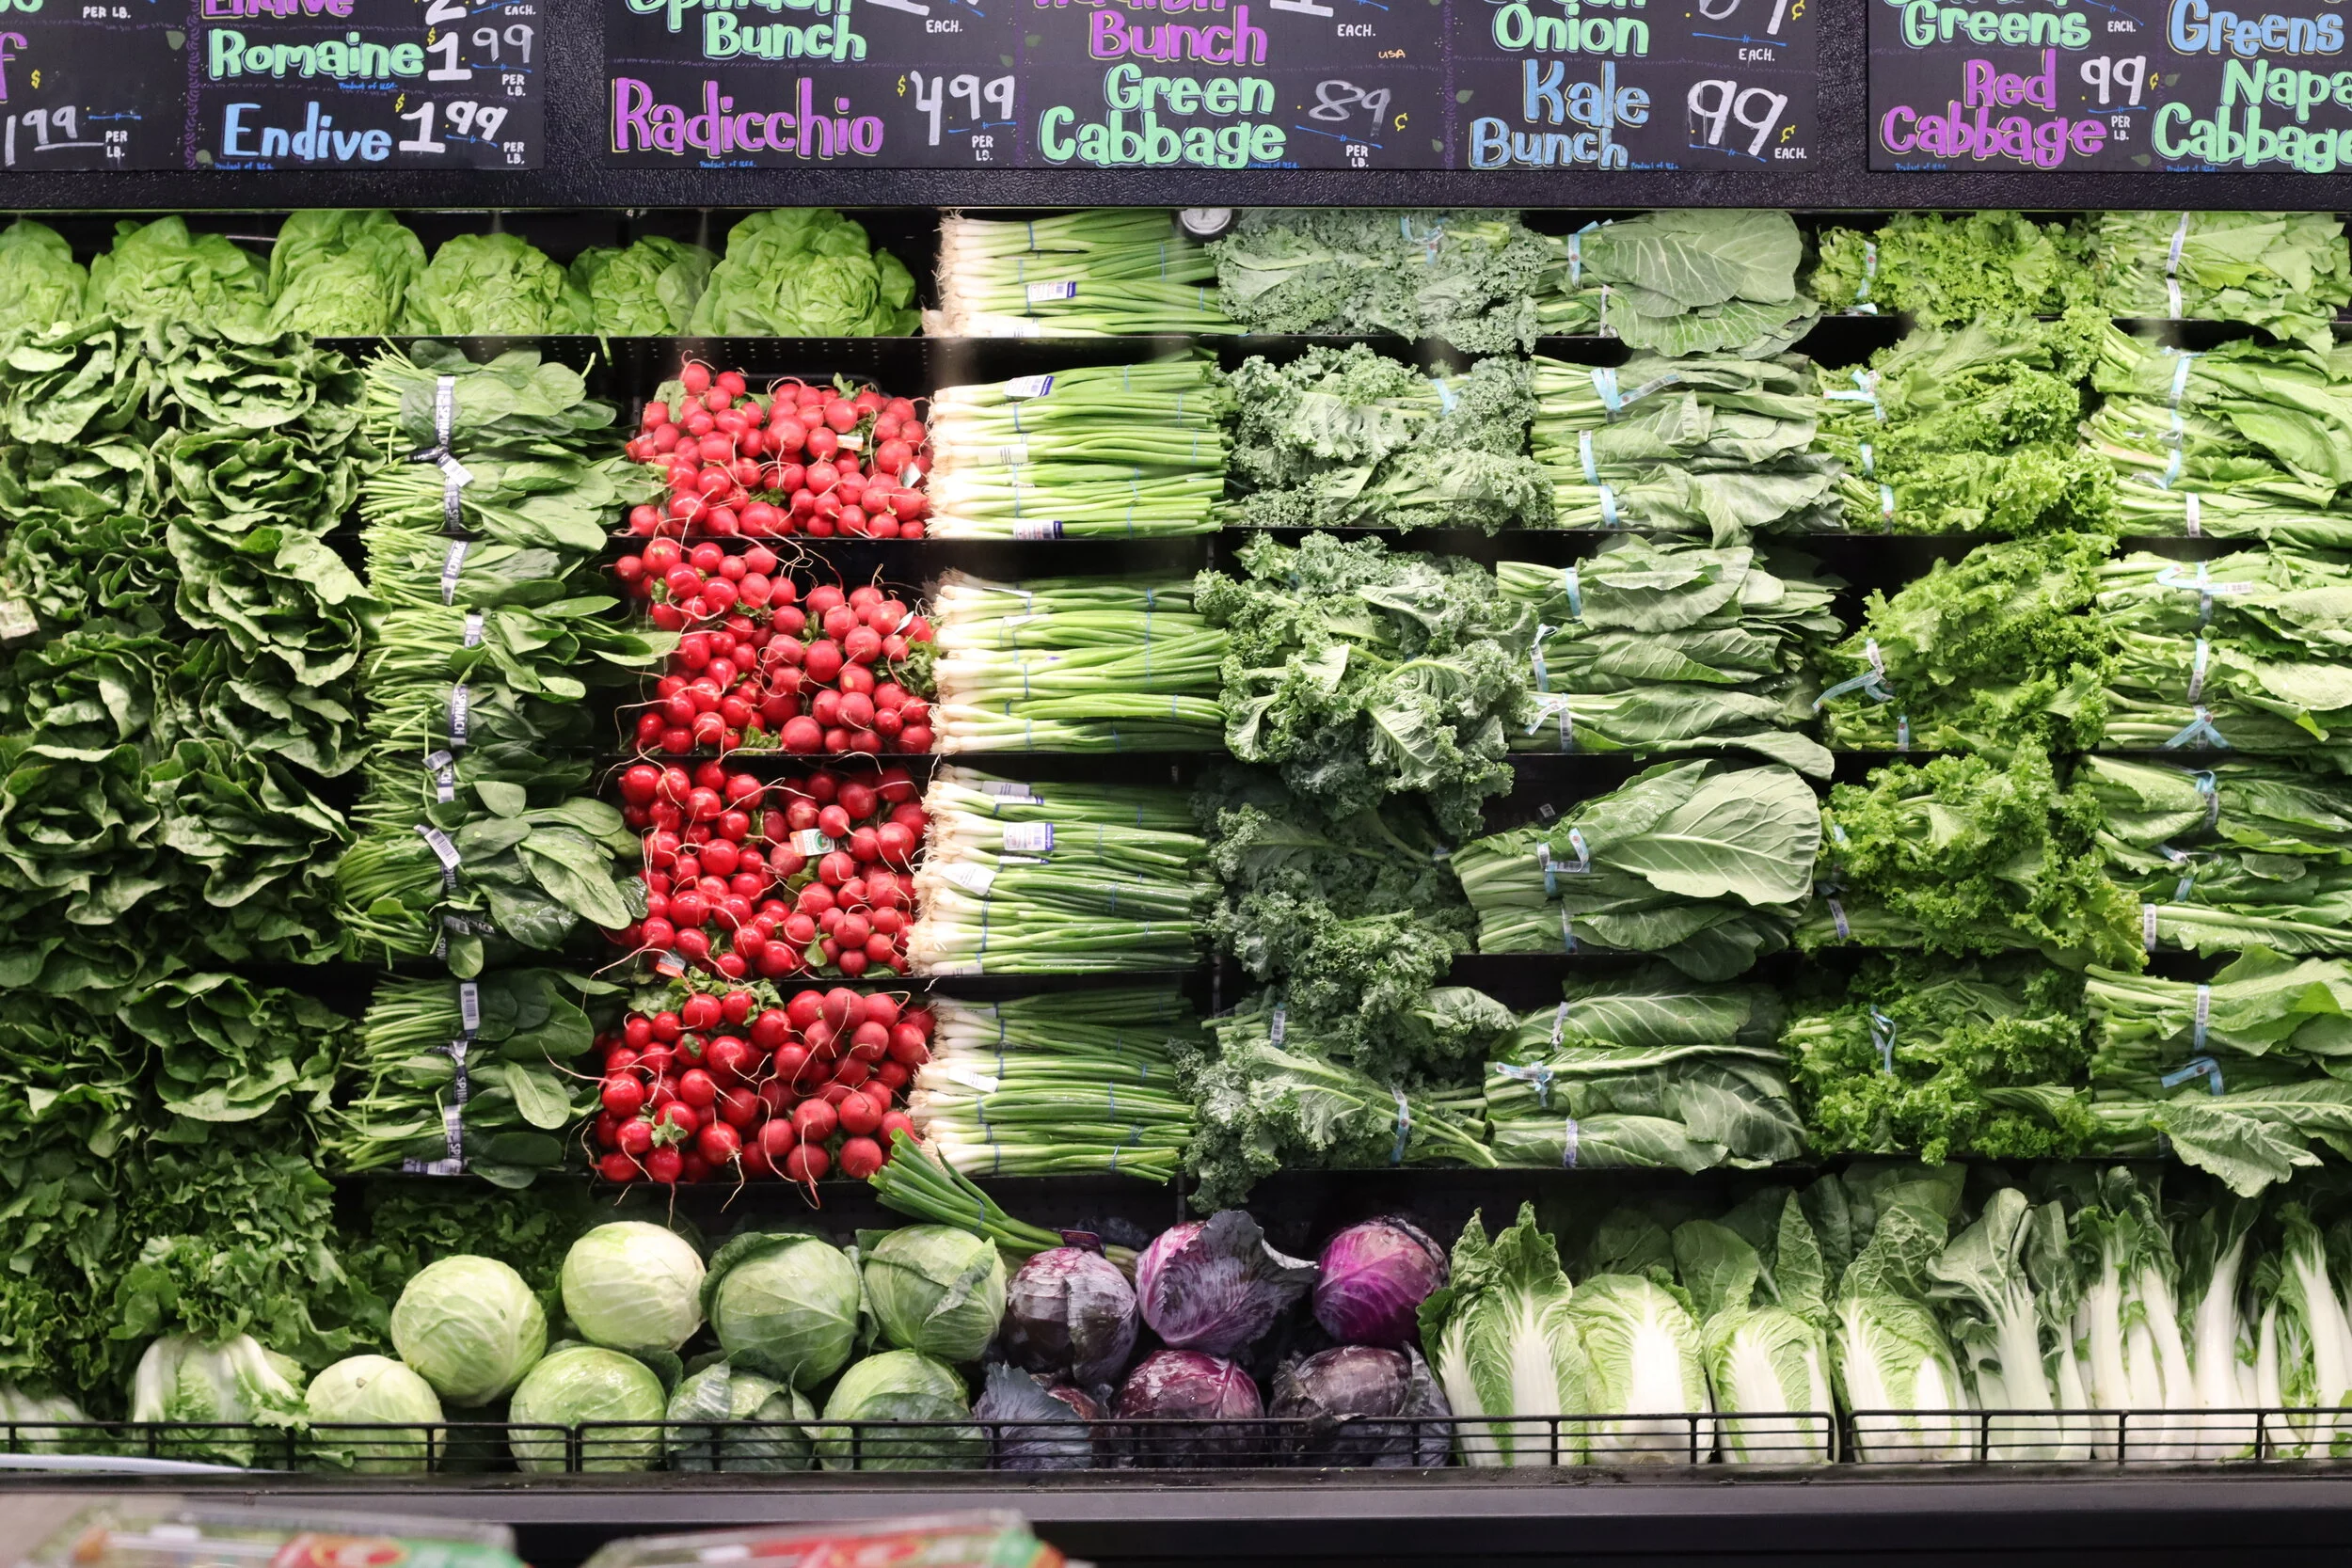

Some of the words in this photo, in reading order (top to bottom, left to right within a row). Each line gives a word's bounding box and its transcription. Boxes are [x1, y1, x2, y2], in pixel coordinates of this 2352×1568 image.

[83, 7, 106, 19] PER
[112, 7, 132, 19] LB.
[505, 6, 536, 16] EACH.
[926, 20, 963, 33] EACH.
[1337, 24, 1376, 37] EACH.
[1492, 3, 1649, 57] Onion
[1900, 0, 2091, 50] Greens
[2107, 21, 2137, 32] EACH.
[2167, 0, 2344, 58] Greens
[703, 11, 866, 63] Bunch
[1089, 5, 1267, 66] Bunch
[209, 28, 424, 81] Romaine
[1378, 49, 1406, 59] USA
[1739, 48, 1775, 62] EACH.
[502, 74, 525, 86] PER
[1963, 48, 2057, 111] Red
[507, 86, 526, 96] LB.
[1104, 63, 1275, 116] Green
[1523, 58, 1650, 130] Kale
[2221, 58, 2352, 124] Napa
[612, 77, 884, 159] Radicchio
[2111, 116, 2130, 128] PER
[105, 131, 128, 142] PER
[220, 101, 392, 162] Endive
[1038, 105, 1286, 169] Cabbage
[1880, 100, 2107, 169] Cabbage
[503, 142, 525, 152] PER
[972, 135, 993, 148] PER
[1469, 117, 1629, 170] Bunch
[106, 146, 125, 157] LB.
[976, 150, 993, 161] LB.
[1346, 145, 1368, 157] PER
[1774, 148, 1807, 159] EACH.
[506, 153, 525, 165] LB.
[1352, 158, 1369, 167] LB.
[453, 694, 467, 735] SPINACH
